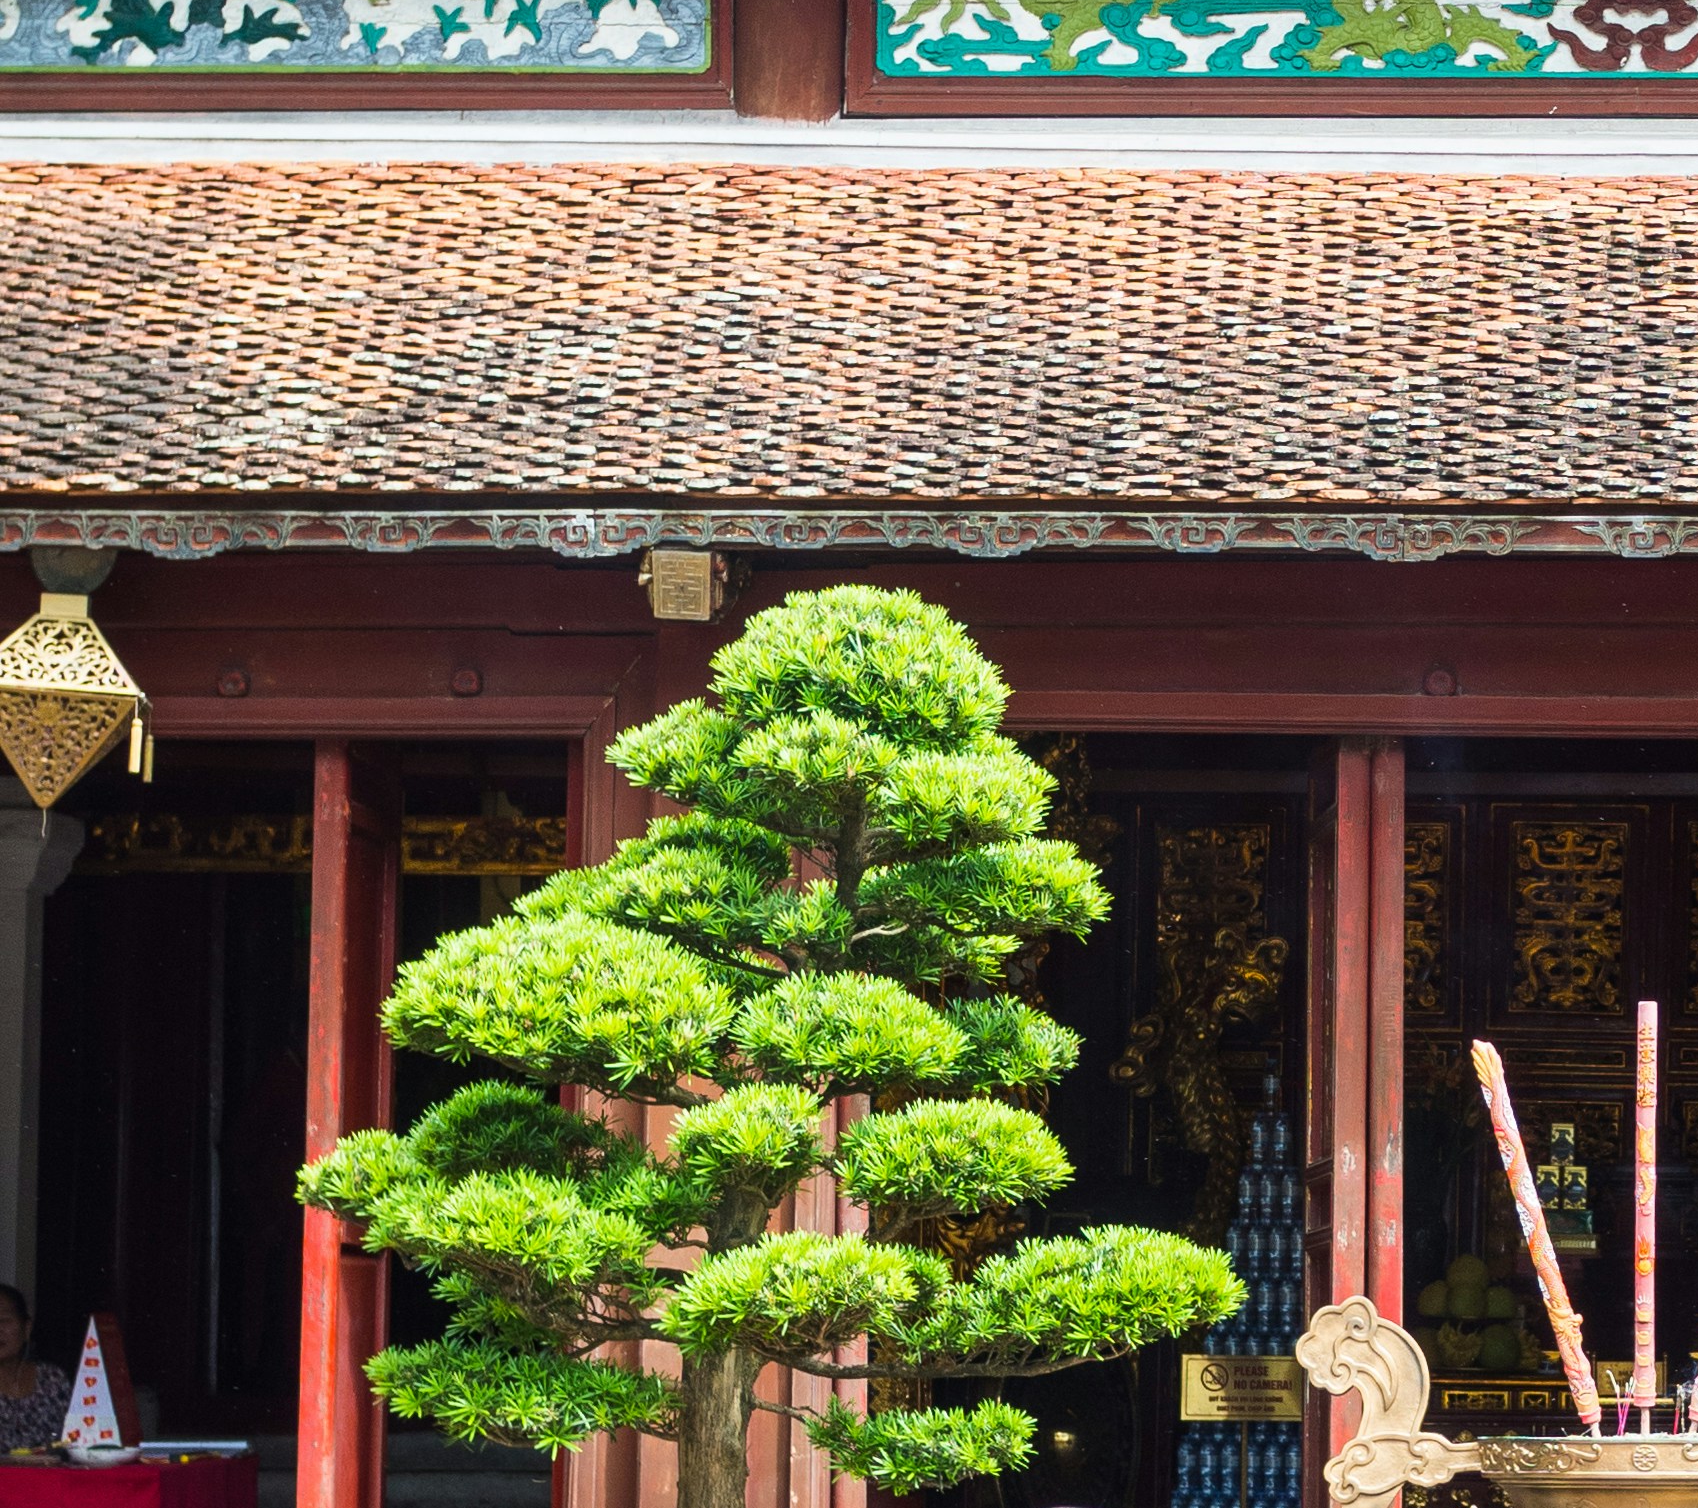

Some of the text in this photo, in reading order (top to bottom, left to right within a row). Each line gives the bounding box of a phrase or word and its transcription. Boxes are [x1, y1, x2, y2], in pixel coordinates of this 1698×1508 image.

[1233, 1366, 1269, 1377] PLEASE
[1233, 1379, 1293, 1390] NO CAMERA!
